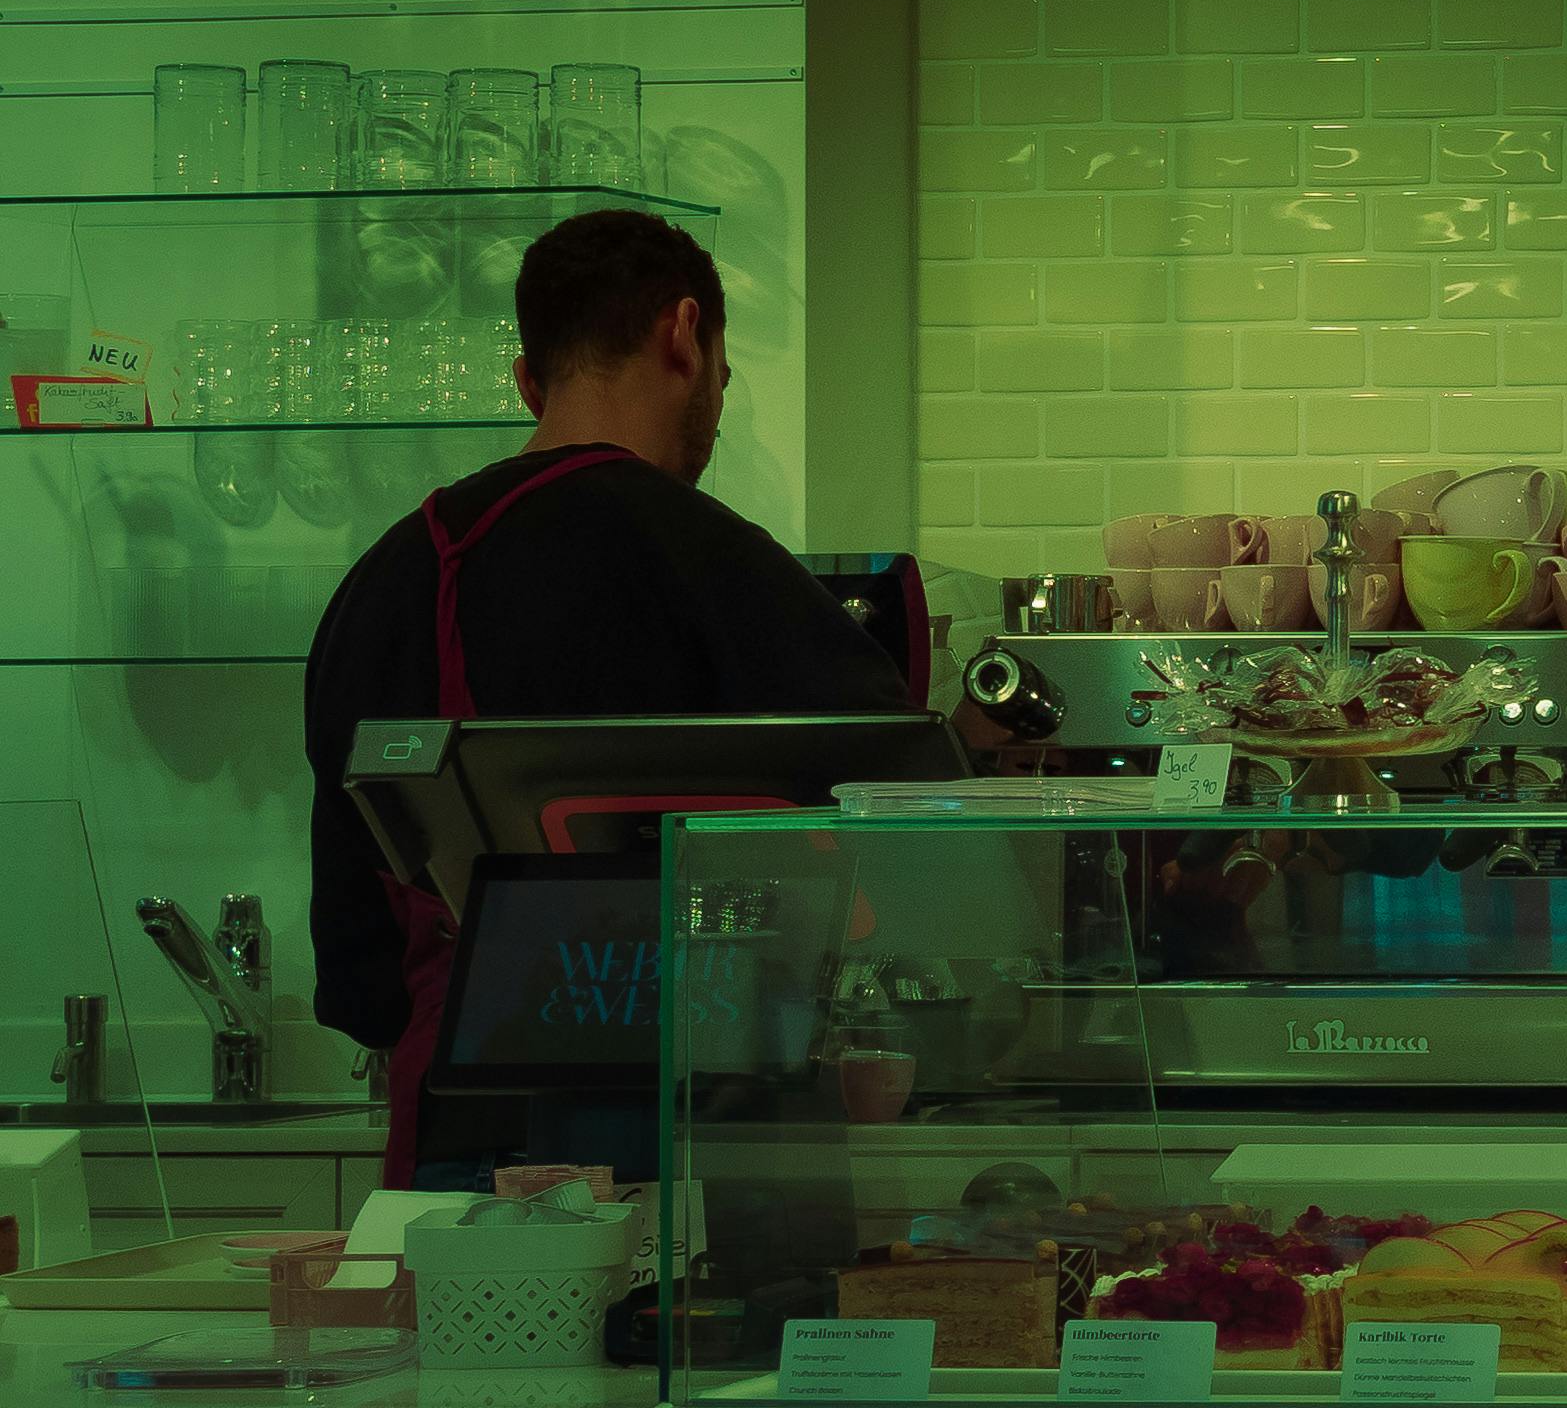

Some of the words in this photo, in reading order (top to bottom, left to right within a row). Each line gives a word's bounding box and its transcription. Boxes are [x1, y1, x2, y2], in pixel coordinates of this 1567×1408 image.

[88, 343, 139, 372] NEU
[557, 942, 737, 982] WEBR
[796, 1327, 851, 1340] Pralinen
[854, 1328, 896, 1340] Sahne
[1072, 1329, 1161, 1341] Himbeertorte
[1359, 1331, 1407, 1343] Karibik
[1411, 1332, 1446, 1343] Torte
